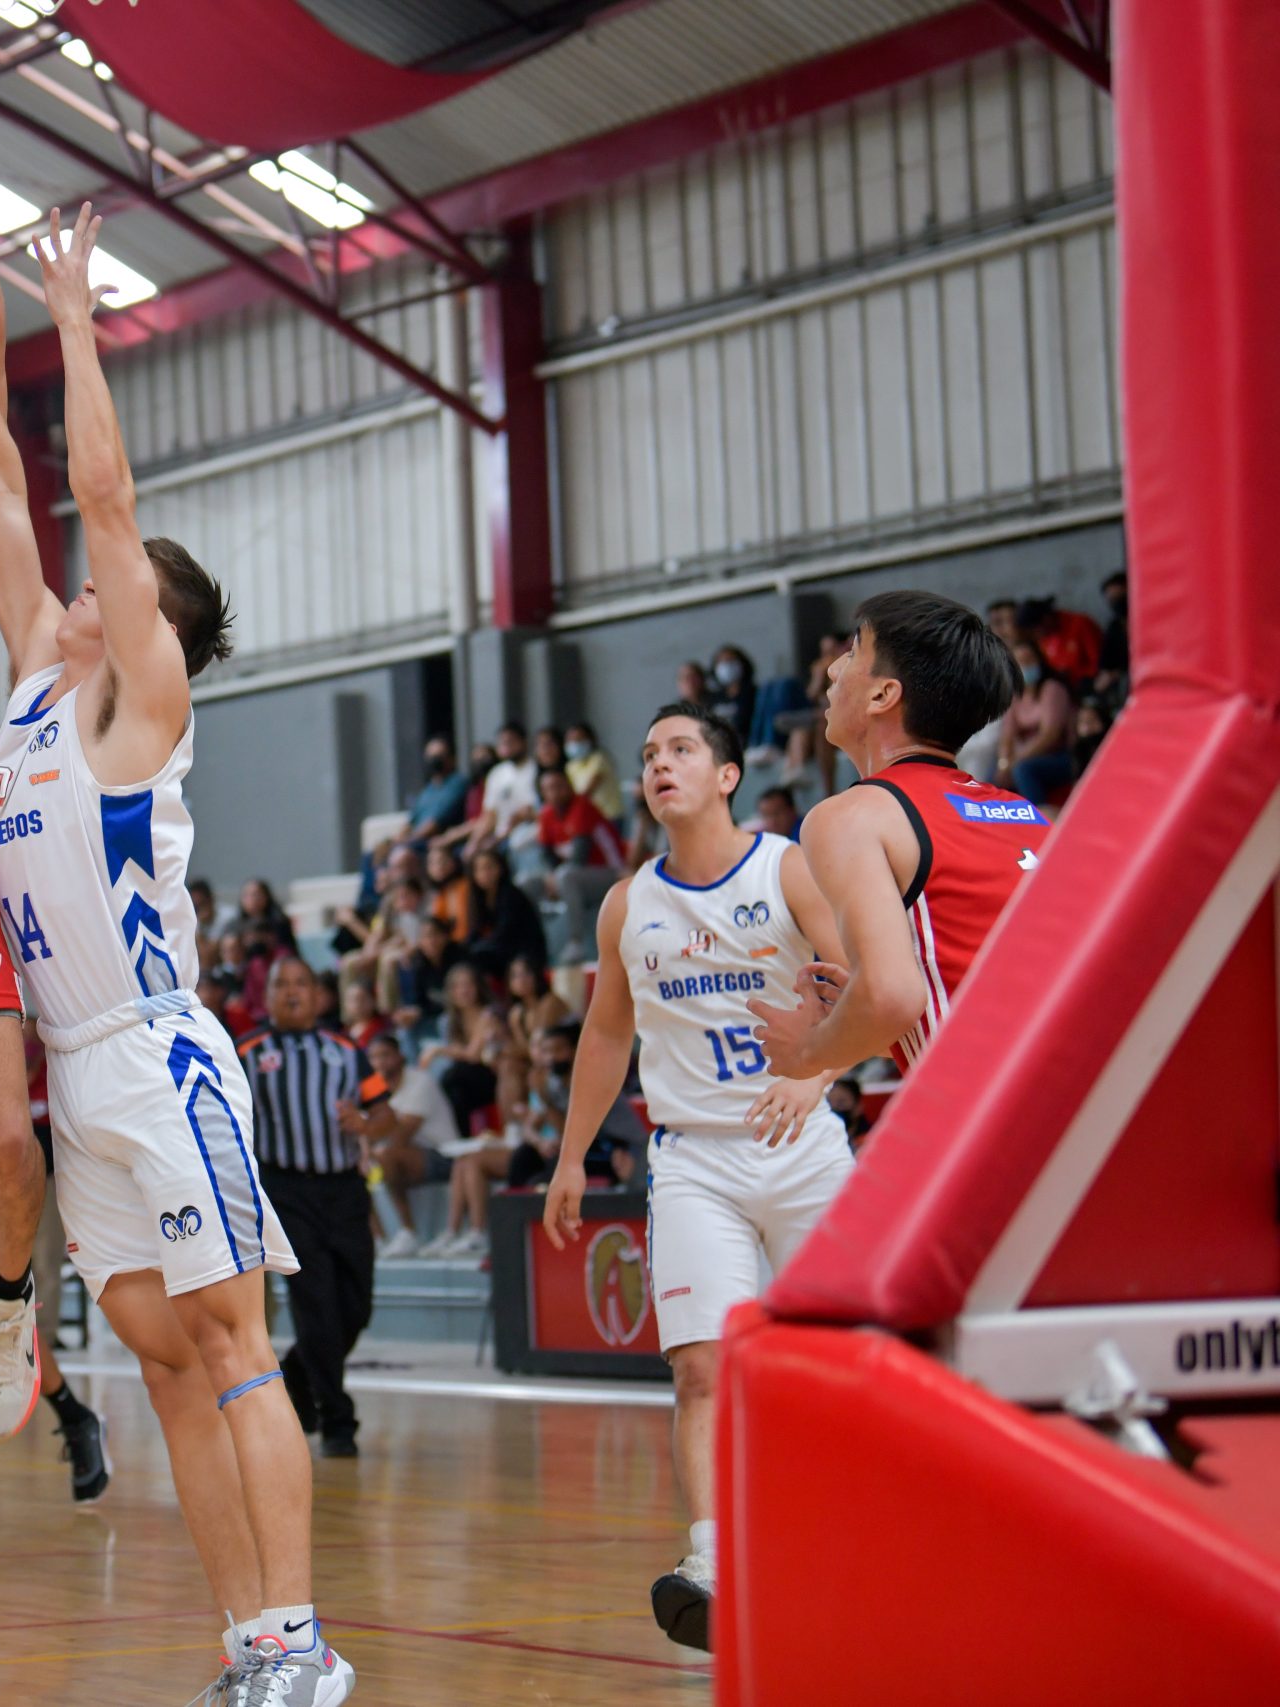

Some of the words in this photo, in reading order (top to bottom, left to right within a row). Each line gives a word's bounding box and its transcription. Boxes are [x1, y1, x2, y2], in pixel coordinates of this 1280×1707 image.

[982, 804, 1035, 821] telcel
[2, 892, 53, 964] 14
[658, 971, 766, 1001] BORREGOS
[704, 1026, 767, 1082] 15
